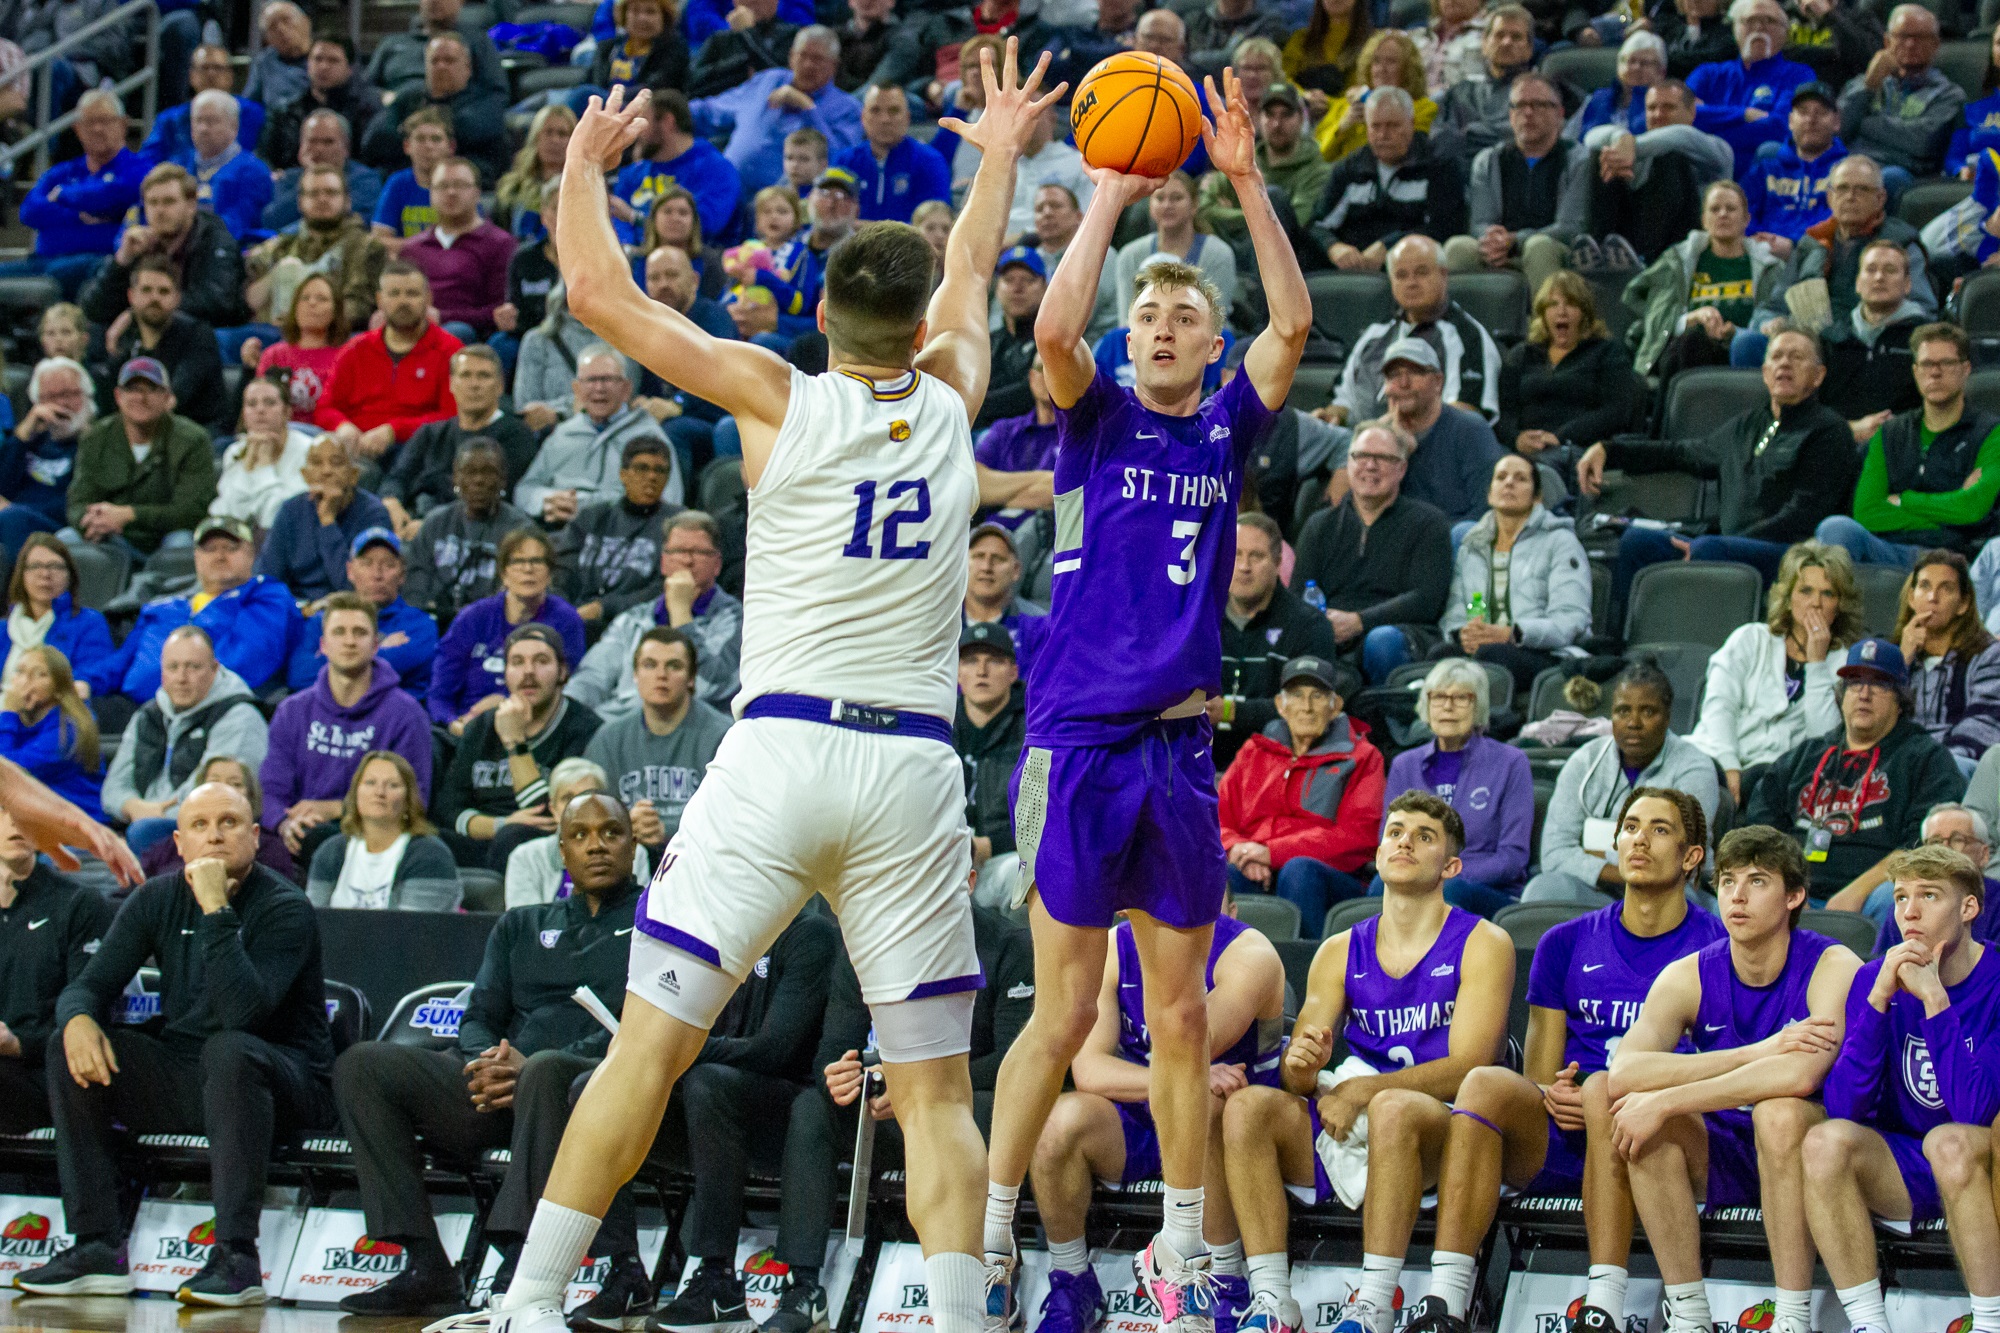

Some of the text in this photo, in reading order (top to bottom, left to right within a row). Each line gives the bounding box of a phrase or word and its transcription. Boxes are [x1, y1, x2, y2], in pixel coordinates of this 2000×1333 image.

[1072, 90, 1098, 136] CAA
[1122, 467, 1157, 501] ST.
[842, 477, 931, 559] 12
[1167, 520, 1203, 586] 3
[1374, 1001, 1455, 1037] THOMAS
[1579, 998, 1605, 1026] ST.
[877, 1311, 914, 1324] FAST.
